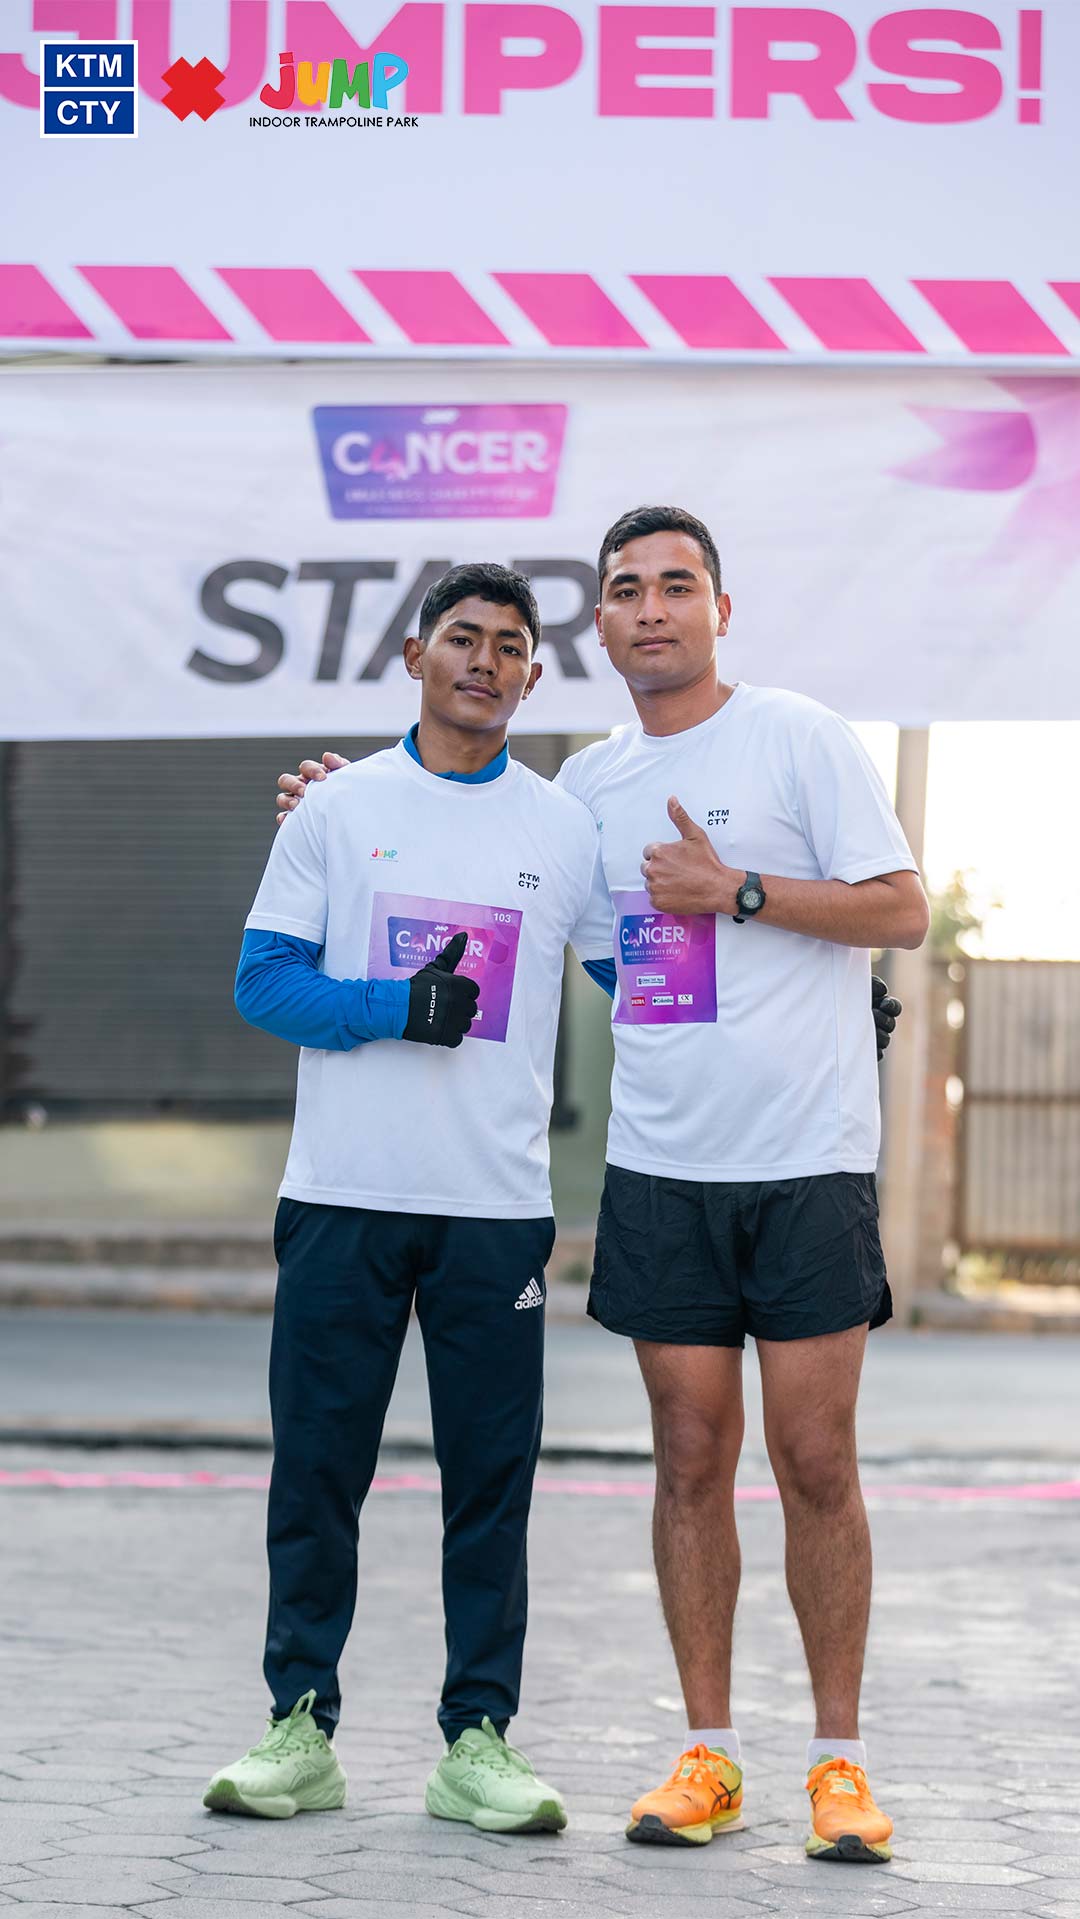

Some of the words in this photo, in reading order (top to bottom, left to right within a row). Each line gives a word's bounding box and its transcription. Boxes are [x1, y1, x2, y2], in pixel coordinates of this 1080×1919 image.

[331, 430, 550, 479] CANCER
[708, 809, 730, 818] KTM
[707, 818, 728, 826] CTY
[519, 871, 540, 883] KTM
[518, 880, 539, 891] CTY
[494, 912, 512, 923] 103
[621, 925, 685, 948] CANCER
[427, 984, 437, 1025] SPORT
